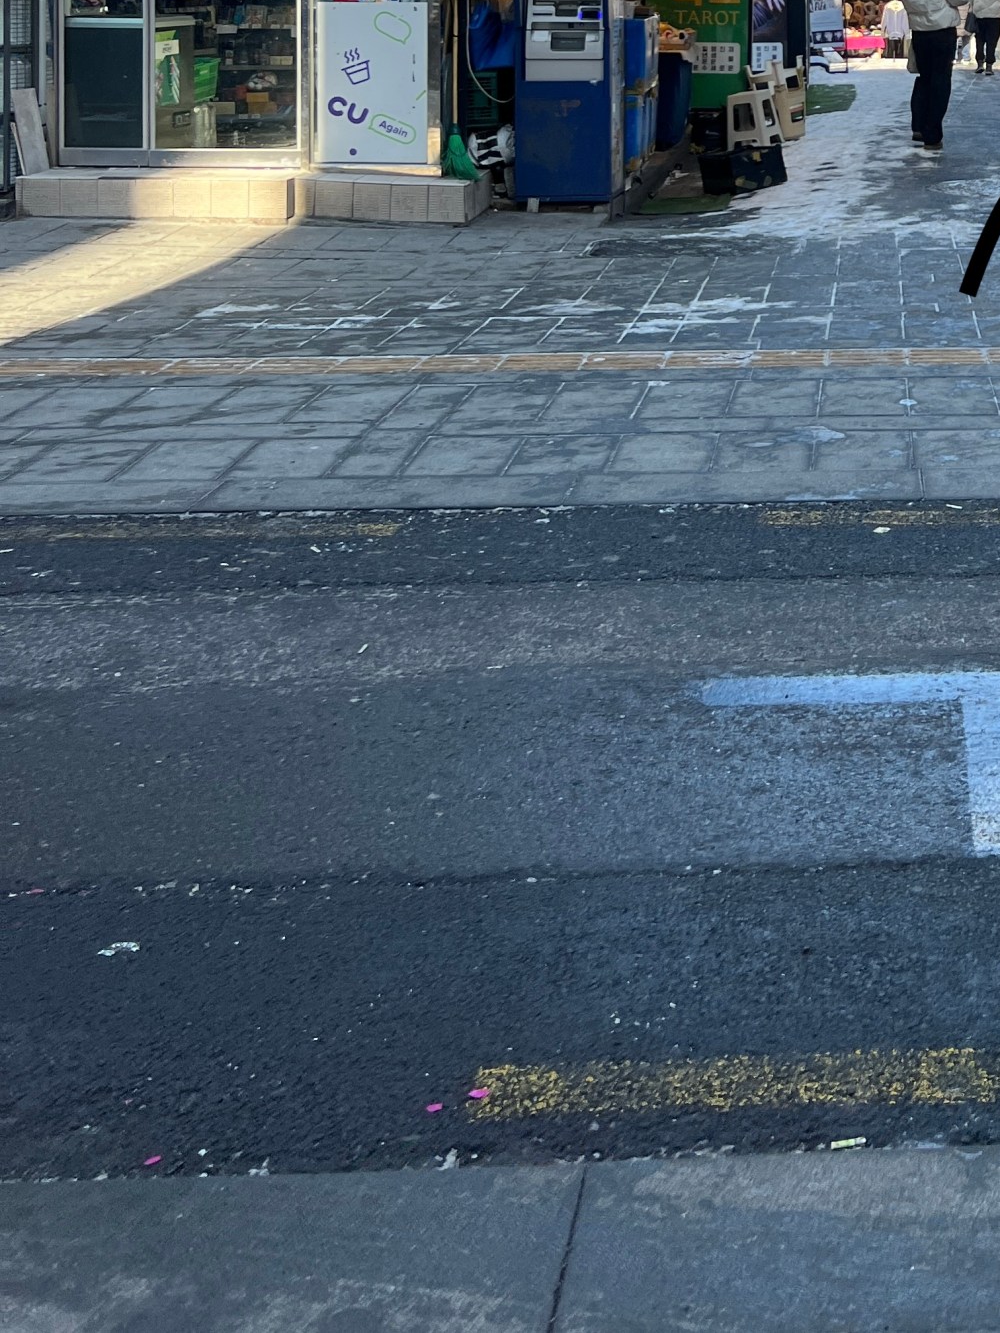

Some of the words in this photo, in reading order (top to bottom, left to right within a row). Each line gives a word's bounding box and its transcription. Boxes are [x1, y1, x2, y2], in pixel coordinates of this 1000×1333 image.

[674, 10, 740, 26] TAROT
[328, 96, 369, 124] CU
[378, 120, 409, 139] Again
